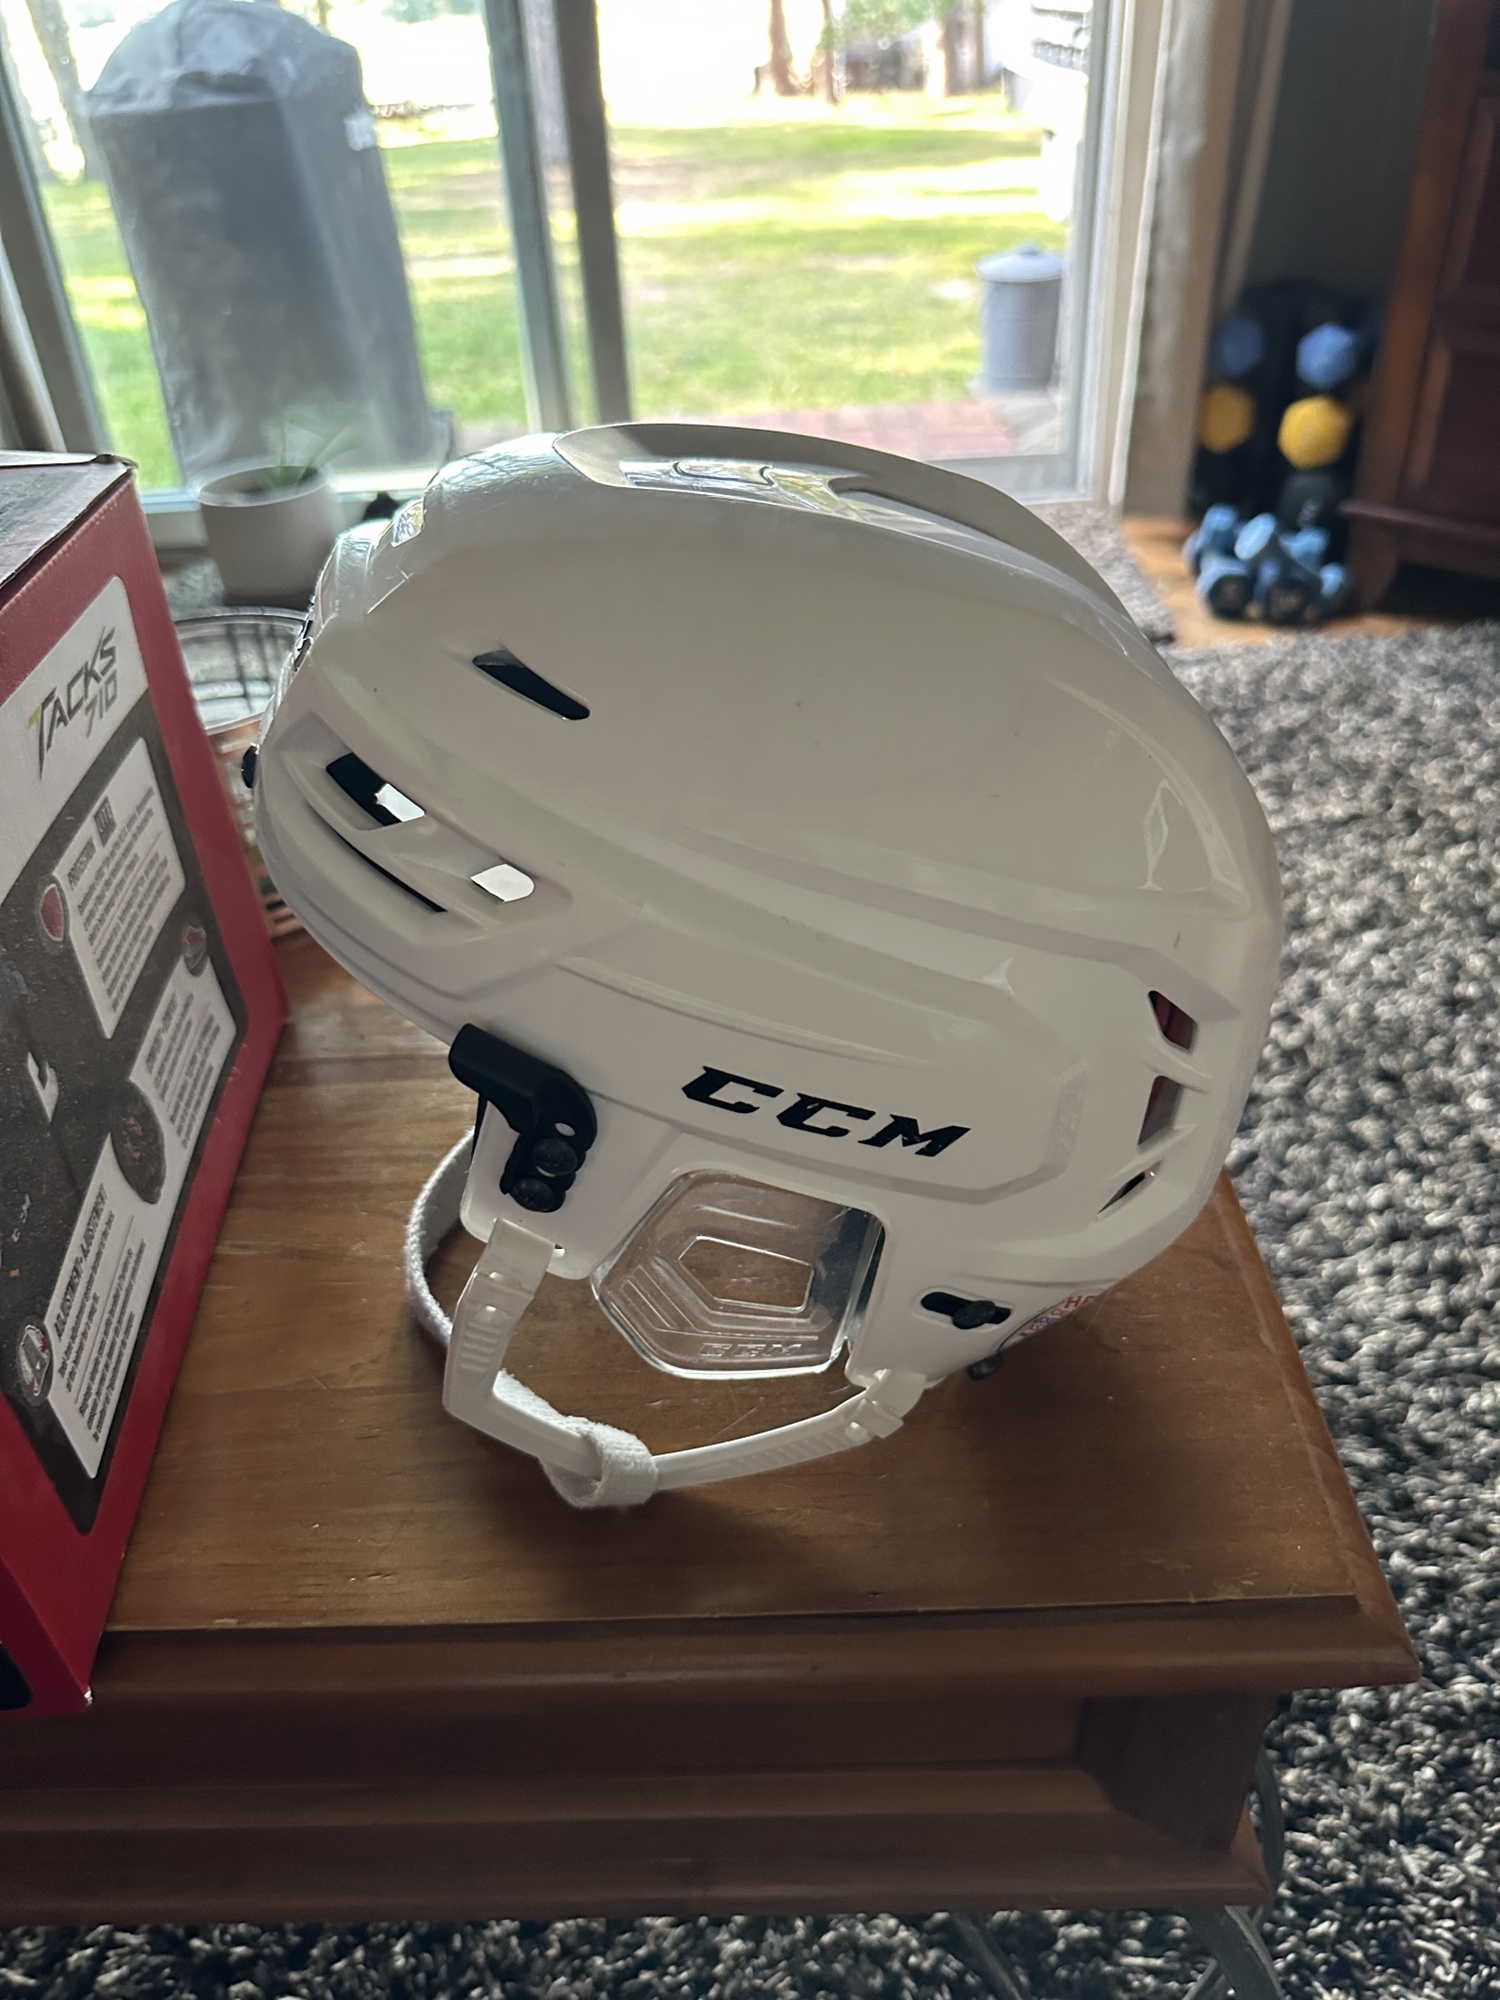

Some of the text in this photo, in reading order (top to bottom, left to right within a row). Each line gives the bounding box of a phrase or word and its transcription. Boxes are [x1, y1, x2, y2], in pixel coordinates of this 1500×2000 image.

[27, 626, 117, 782] TACKS
[84, 671, 118, 739] 710
[681, 1065, 971, 1157] CCM
